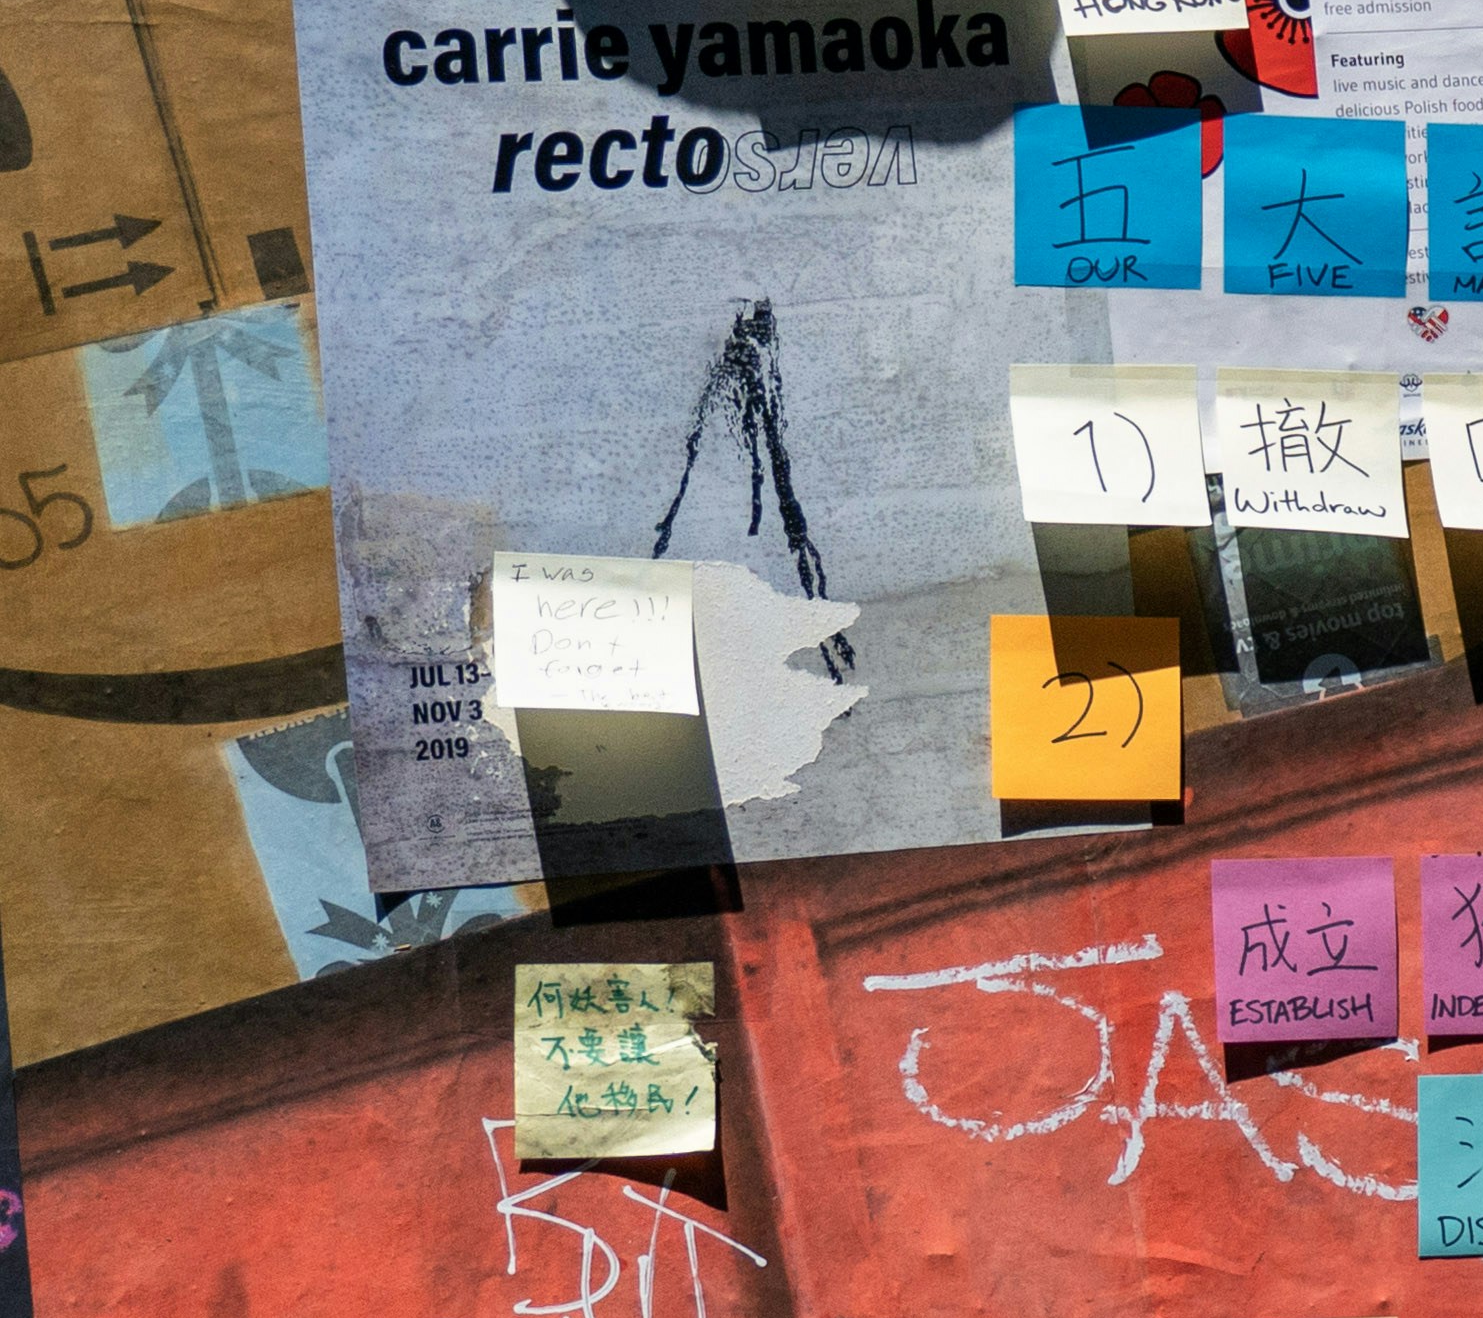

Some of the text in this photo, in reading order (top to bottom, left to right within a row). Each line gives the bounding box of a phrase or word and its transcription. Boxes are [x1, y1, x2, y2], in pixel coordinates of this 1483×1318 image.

[382, 8, 629, 87] carrie
[492, 114, 725, 194] recto
[1051, 146, 1151, 250] 五
[1260, 169, 1362, 265] 大
[1066, 256, 1147, 284] OUR
[1268, 264, 1355, 291] FIVE
[1239, 399, 1371, 478] 撤
[1233, 486, 1387, 518] Withdraw
[409, 666, 450, 690] JUL
[412, 700, 482, 725] NOV 3
[416, 736, 469, 761] 2019
[1229, 989, 1374, 1025] ESTABLISH
